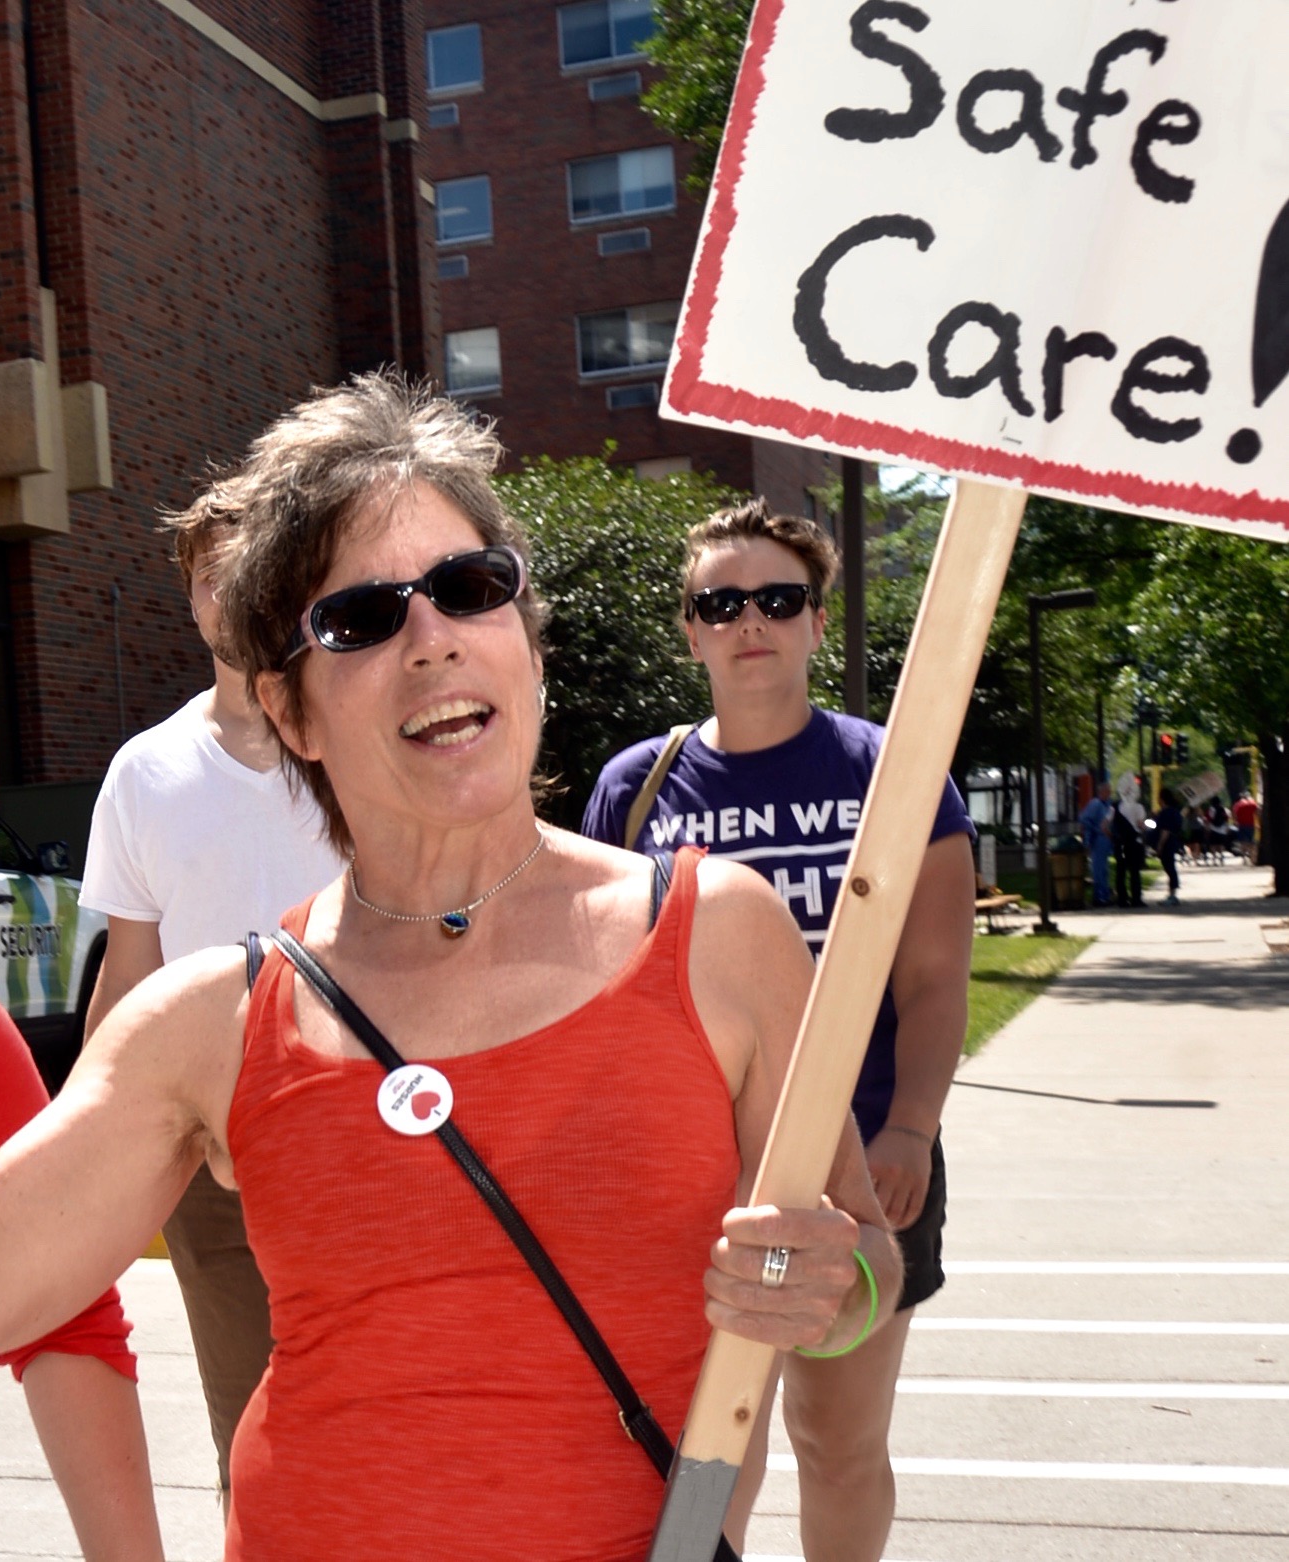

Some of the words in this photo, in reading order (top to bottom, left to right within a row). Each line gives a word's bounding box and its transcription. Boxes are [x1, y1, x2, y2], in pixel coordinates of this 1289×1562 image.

[824, 0, 1202, 204] Safe
[793, 213, 1289, 464] Care!
[649, 803, 775, 847] WHEN
[790, 799, 861, 836] WE
[0, 924, 63, 958] SECURITY
